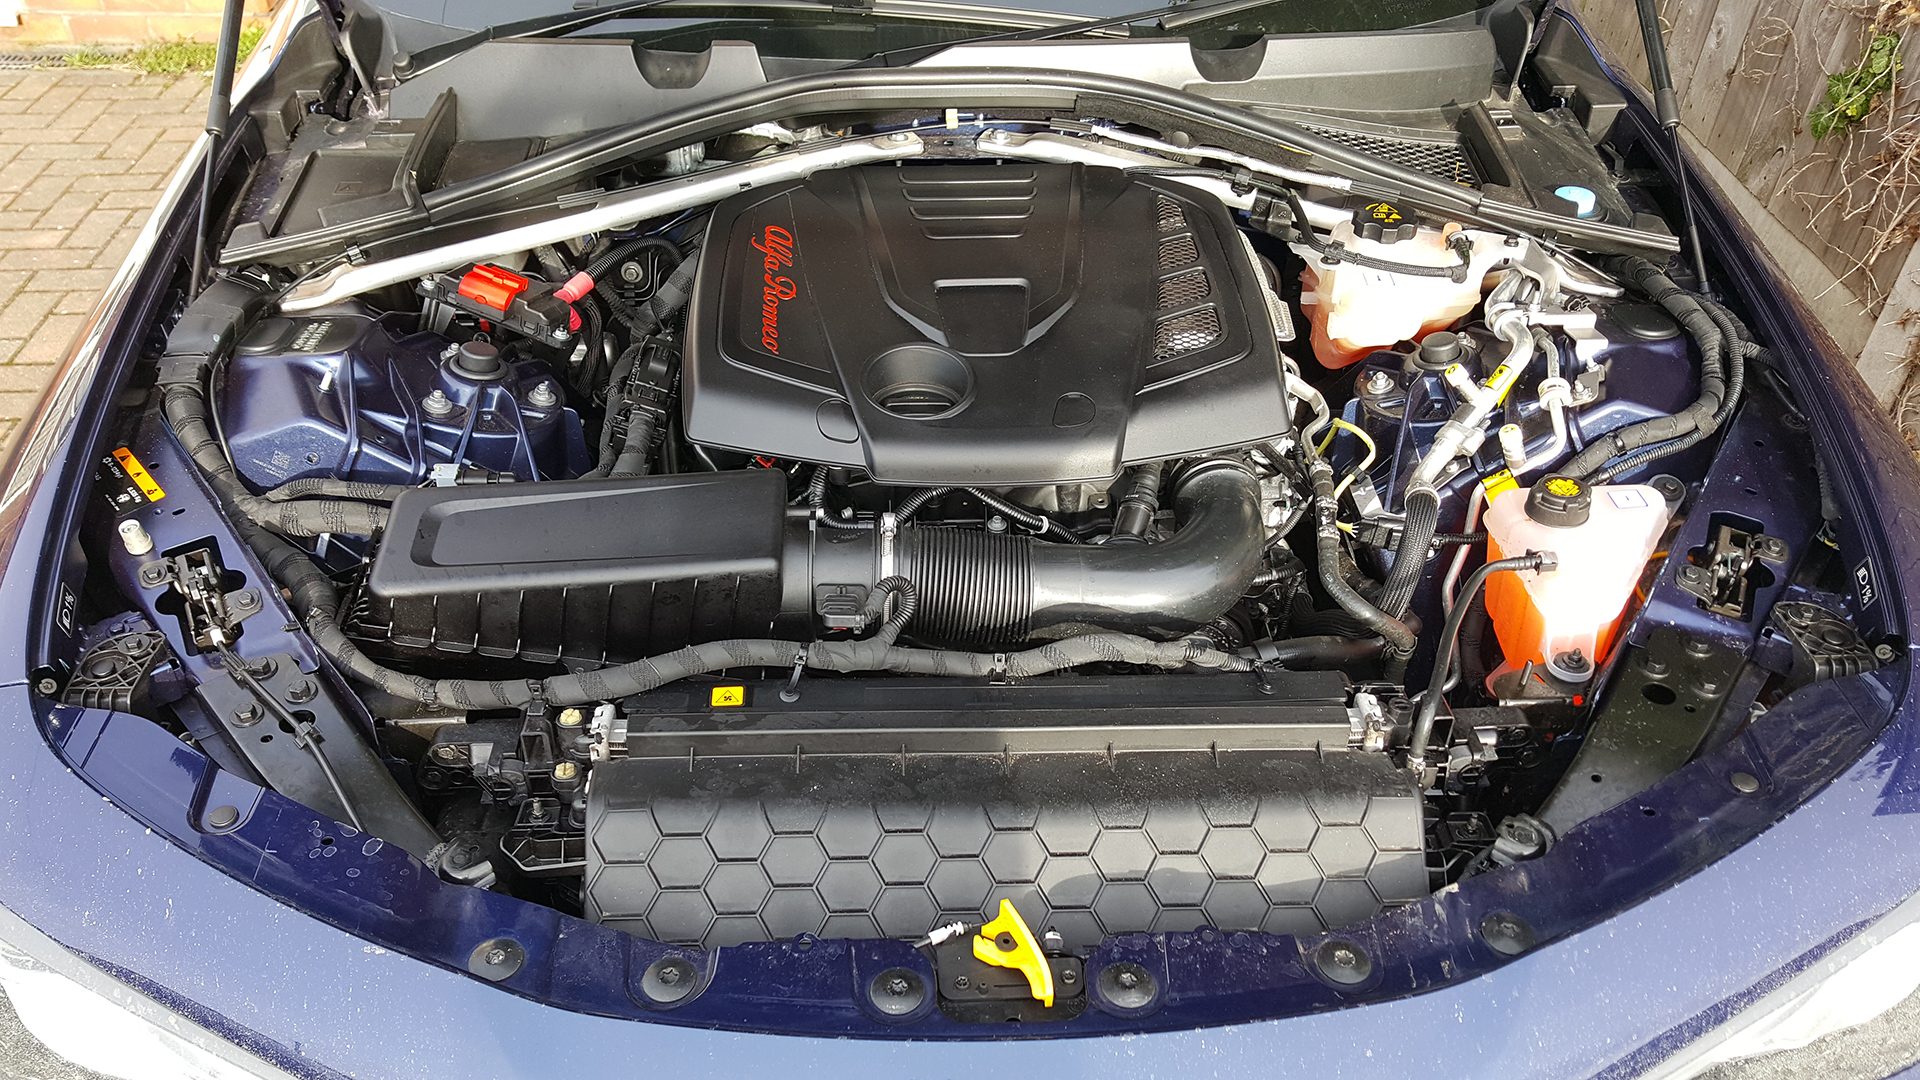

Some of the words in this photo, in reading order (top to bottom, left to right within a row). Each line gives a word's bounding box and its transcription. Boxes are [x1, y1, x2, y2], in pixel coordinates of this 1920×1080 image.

[751, 225, 793, 274] Alfa
[762, 273, 797, 355] Romeo
[65, 592, 74, 610] 1%
[1861, 585, 1872, 603] 1%
